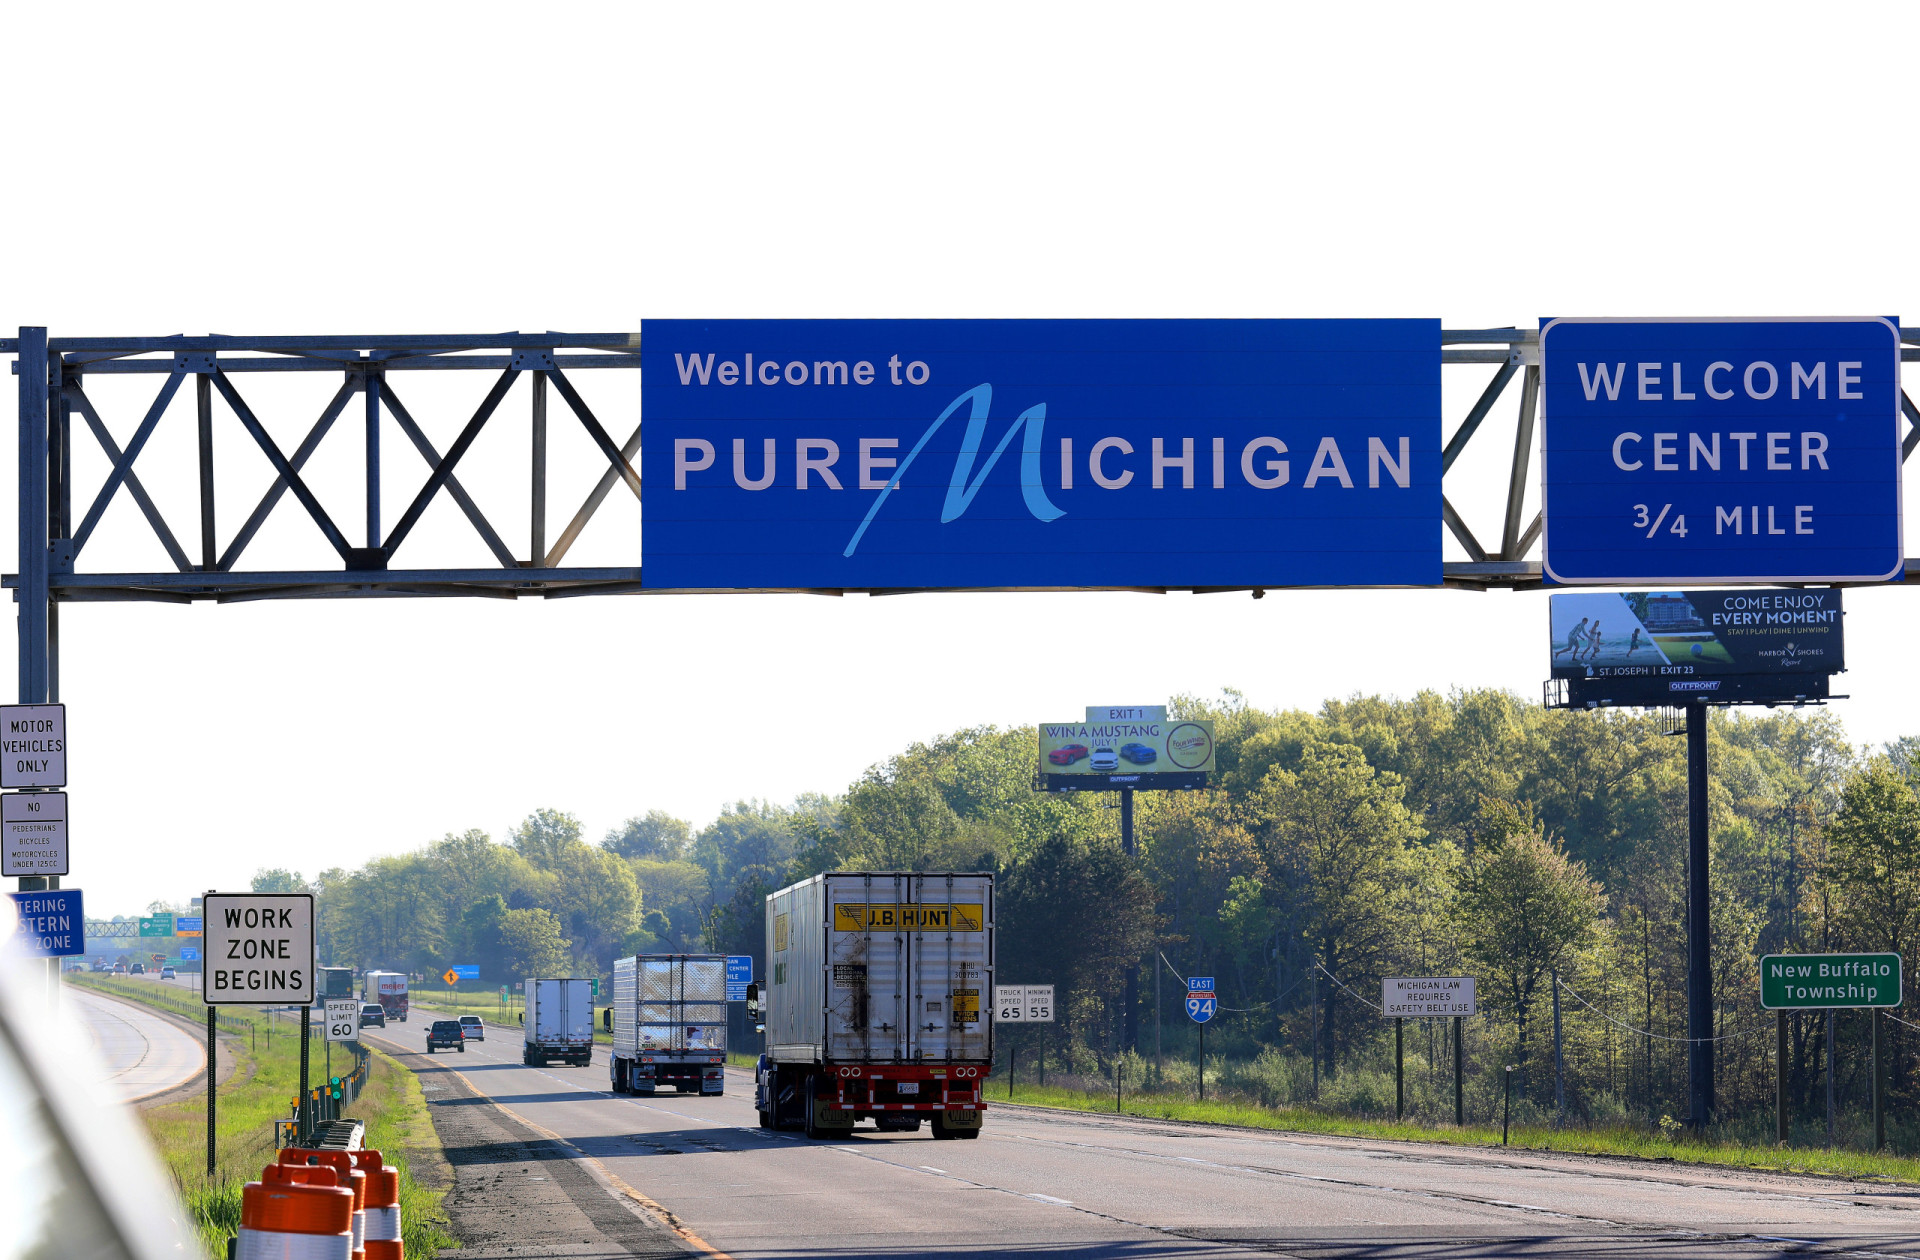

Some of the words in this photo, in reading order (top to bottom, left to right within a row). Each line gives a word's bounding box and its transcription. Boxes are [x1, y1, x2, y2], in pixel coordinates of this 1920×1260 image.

[674, 353, 875, 386] Welcome
[888, 355, 931, 386] to
[1577, 361, 1864, 401] WELCOME
[1612, 431, 1830, 471] CENTER
[674, 438, 901, 490] PURE
[843, 382, 1411, 557] MICHIGAN
[1633, 503, 1688, 538] 3/4
[1715, 505, 1815, 535] MILE
[1724, 597, 1770, 609] COME
[1774, 595, 1824, 608] ENJOY
[1712, 612, 1762, 625] EVERY
[1766, 610, 1836, 624] MOMENT
[1773, 627, 1792, 635] DINE
[1797, 626, 1829, 634] UNWIND
[1599, 668, 1612, 676] ST.
[1614, 667, 1648, 675] JOSEPH
[1660, 666, 1681, 675] EXIT
[1684, 666, 1694, 674] 23
[1671, 682, 1718, 690] OUTFRONT
[1110, 709, 1134, 719] EXIT
[1139, 709, 1143, 719] 1
[11, 720, 53, 733] MOTOR
[1046, 727, 1075, 738] WIN
[1078, 727, 1089, 738] A
[1091, 725, 1160, 738] MUSTANG
[3, 740, 62, 753] VEHICLES
[1091, 739, 1111, 748] JULY
[1113, 739, 1118, 747] 1
[17, 760, 49, 773] ONLY
[27, 802, 41, 812] NO
[12, 850, 58, 858] MOTORCYCLES
[16, 899, 66, 913] TERING
[18, 915, 70, 934] STERN
[225, 908, 293, 928] WORK
[867, 911, 897, 925] J.B.
[903, 911, 953, 925] HUNT
[35, 936, 71, 950] ZONE
[227, 939, 290, 959] ZONE
[1771, 964, 1811, 977] New
[1819, 962, 1890, 977] Buffalo
[215, 970, 303, 990] BEGINS
[1191, 979, 1211, 989] EAST
[1397, 982, 1440, 990] MICHIGAN
[1443, 981, 1460, 989] LAW
[1407, 993, 1451, 1001] REQUIRES
[1784, 983, 1877, 1002] Township
[1001, 1007, 1020, 1018] 65
[1030, 1007, 1049, 1017] 55
[1188, 999, 1213, 1016] 94
[1390, 1004, 1423, 1012] SAFETY
[1427, 1004, 1448, 1012] BELT
[332, 1024, 352, 1036] 60
